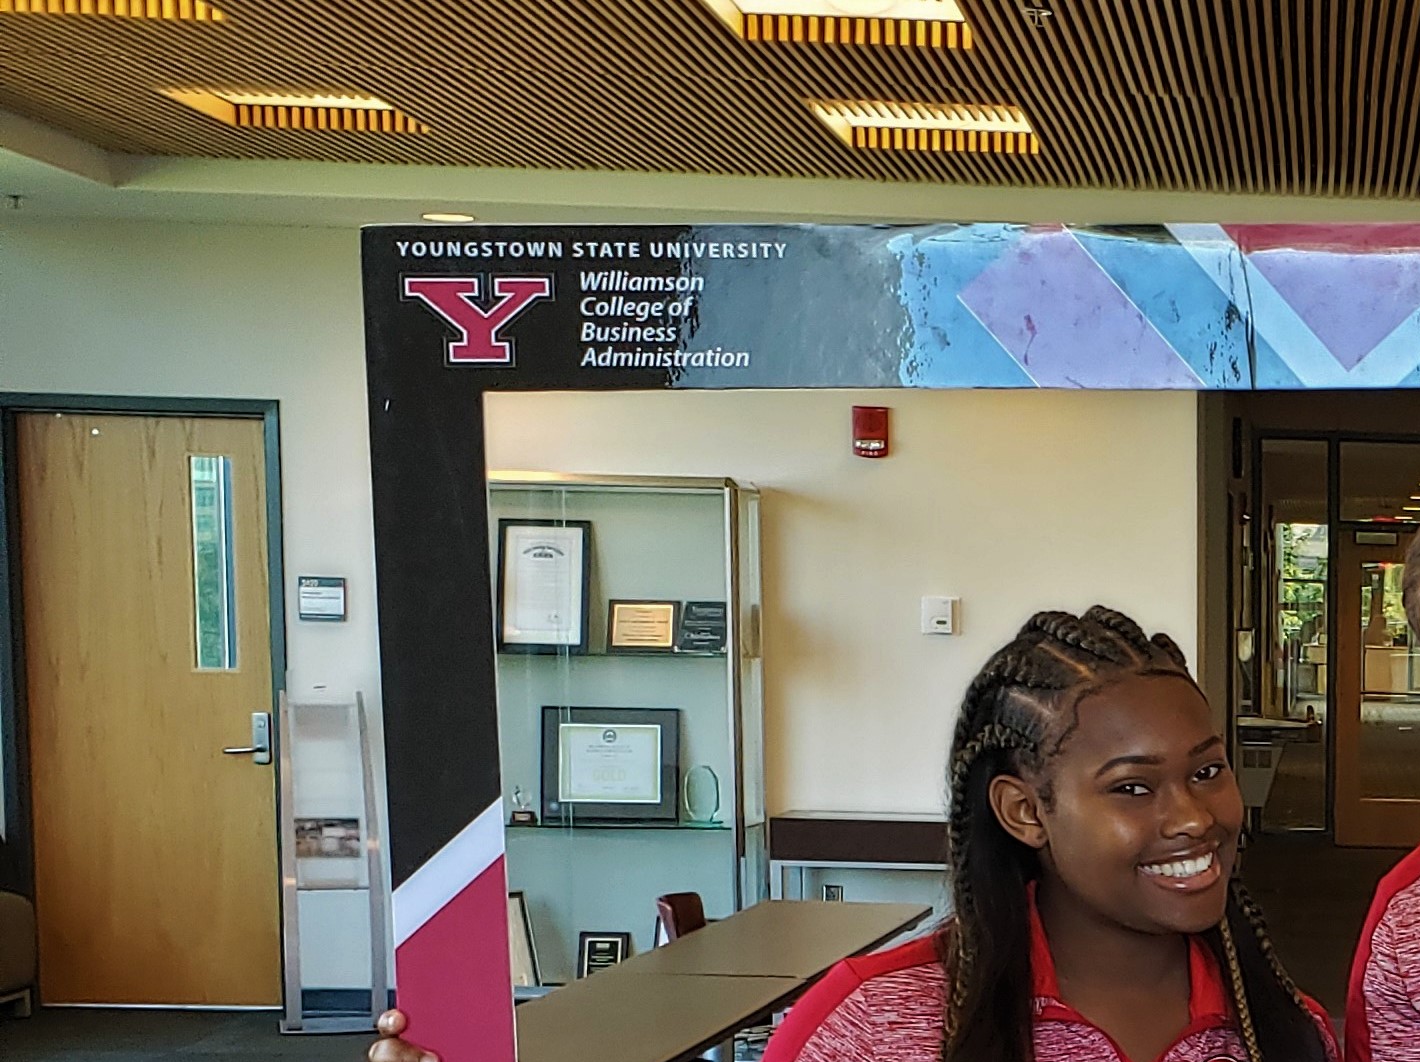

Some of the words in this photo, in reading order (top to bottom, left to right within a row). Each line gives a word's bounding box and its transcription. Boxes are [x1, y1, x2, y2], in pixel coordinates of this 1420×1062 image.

[396, 241, 563, 259] YOUNGSTOWN
[572, 242, 641, 259] STATE
[649, 242, 787, 259] UNIVERSITY
[579, 269, 705, 292] Williamson
[402, 274, 553, 365] Y
[579, 295, 664, 322] College
[667, 296, 694, 317] of
[580, 321, 677, 342] Business
[580, 346, 750, 368] Administration
